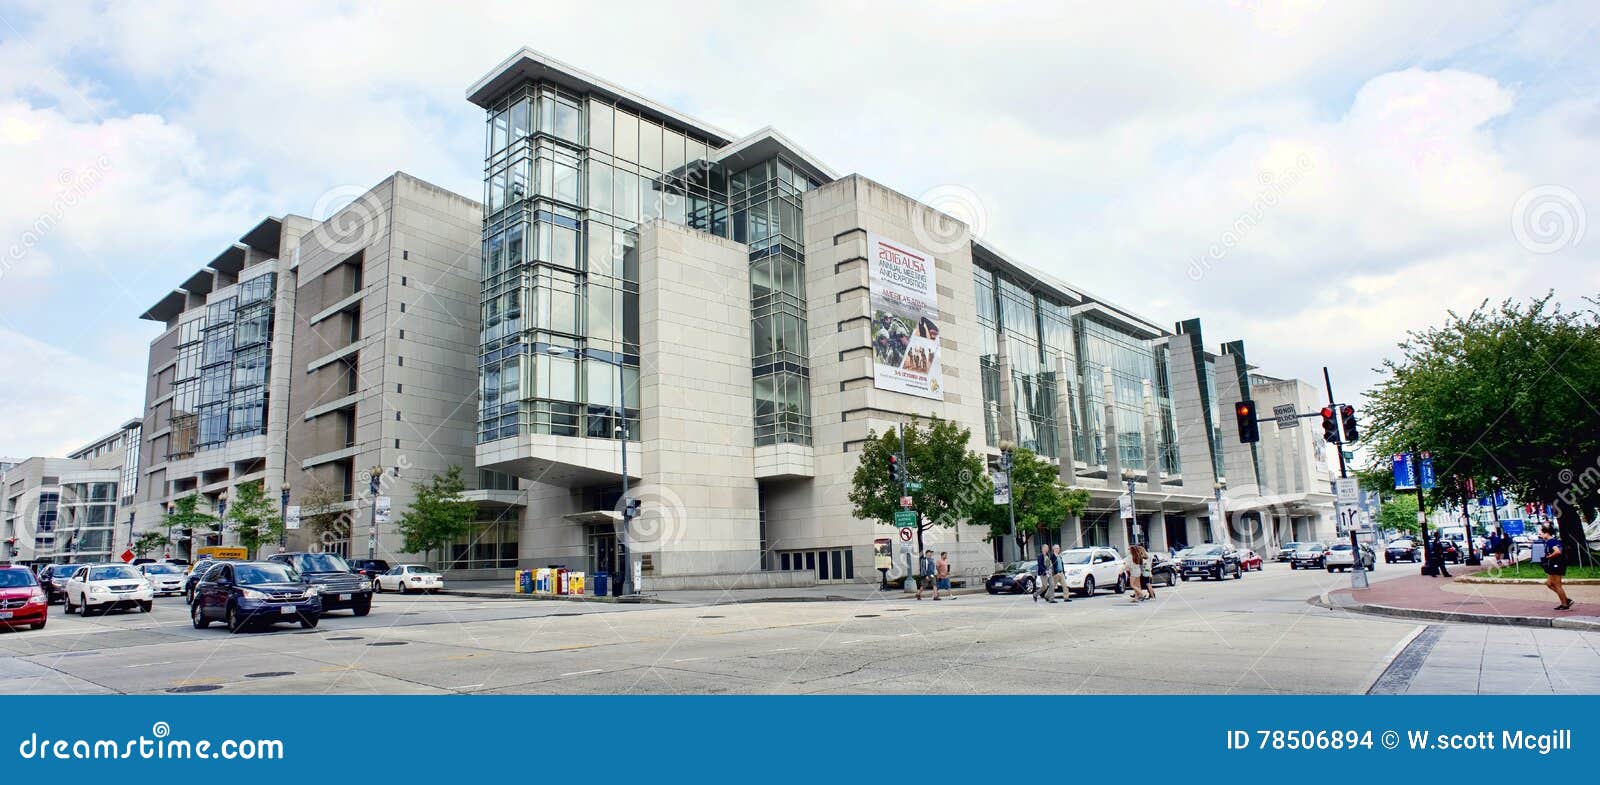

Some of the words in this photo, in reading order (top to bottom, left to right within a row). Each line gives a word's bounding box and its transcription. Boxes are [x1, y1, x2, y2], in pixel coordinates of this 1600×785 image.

[879, 247, 901, 265] 2016
[901, 257, 926, 274] AUSA
[879, 260, 902, 274] ANNUAL
[902, 268, 927, 282] MEETING
[879, 268, 892, 279] AND
[893, 273, 928, 290] EXPOSITION
[1277, 414, 1297, 423] BLOCK
